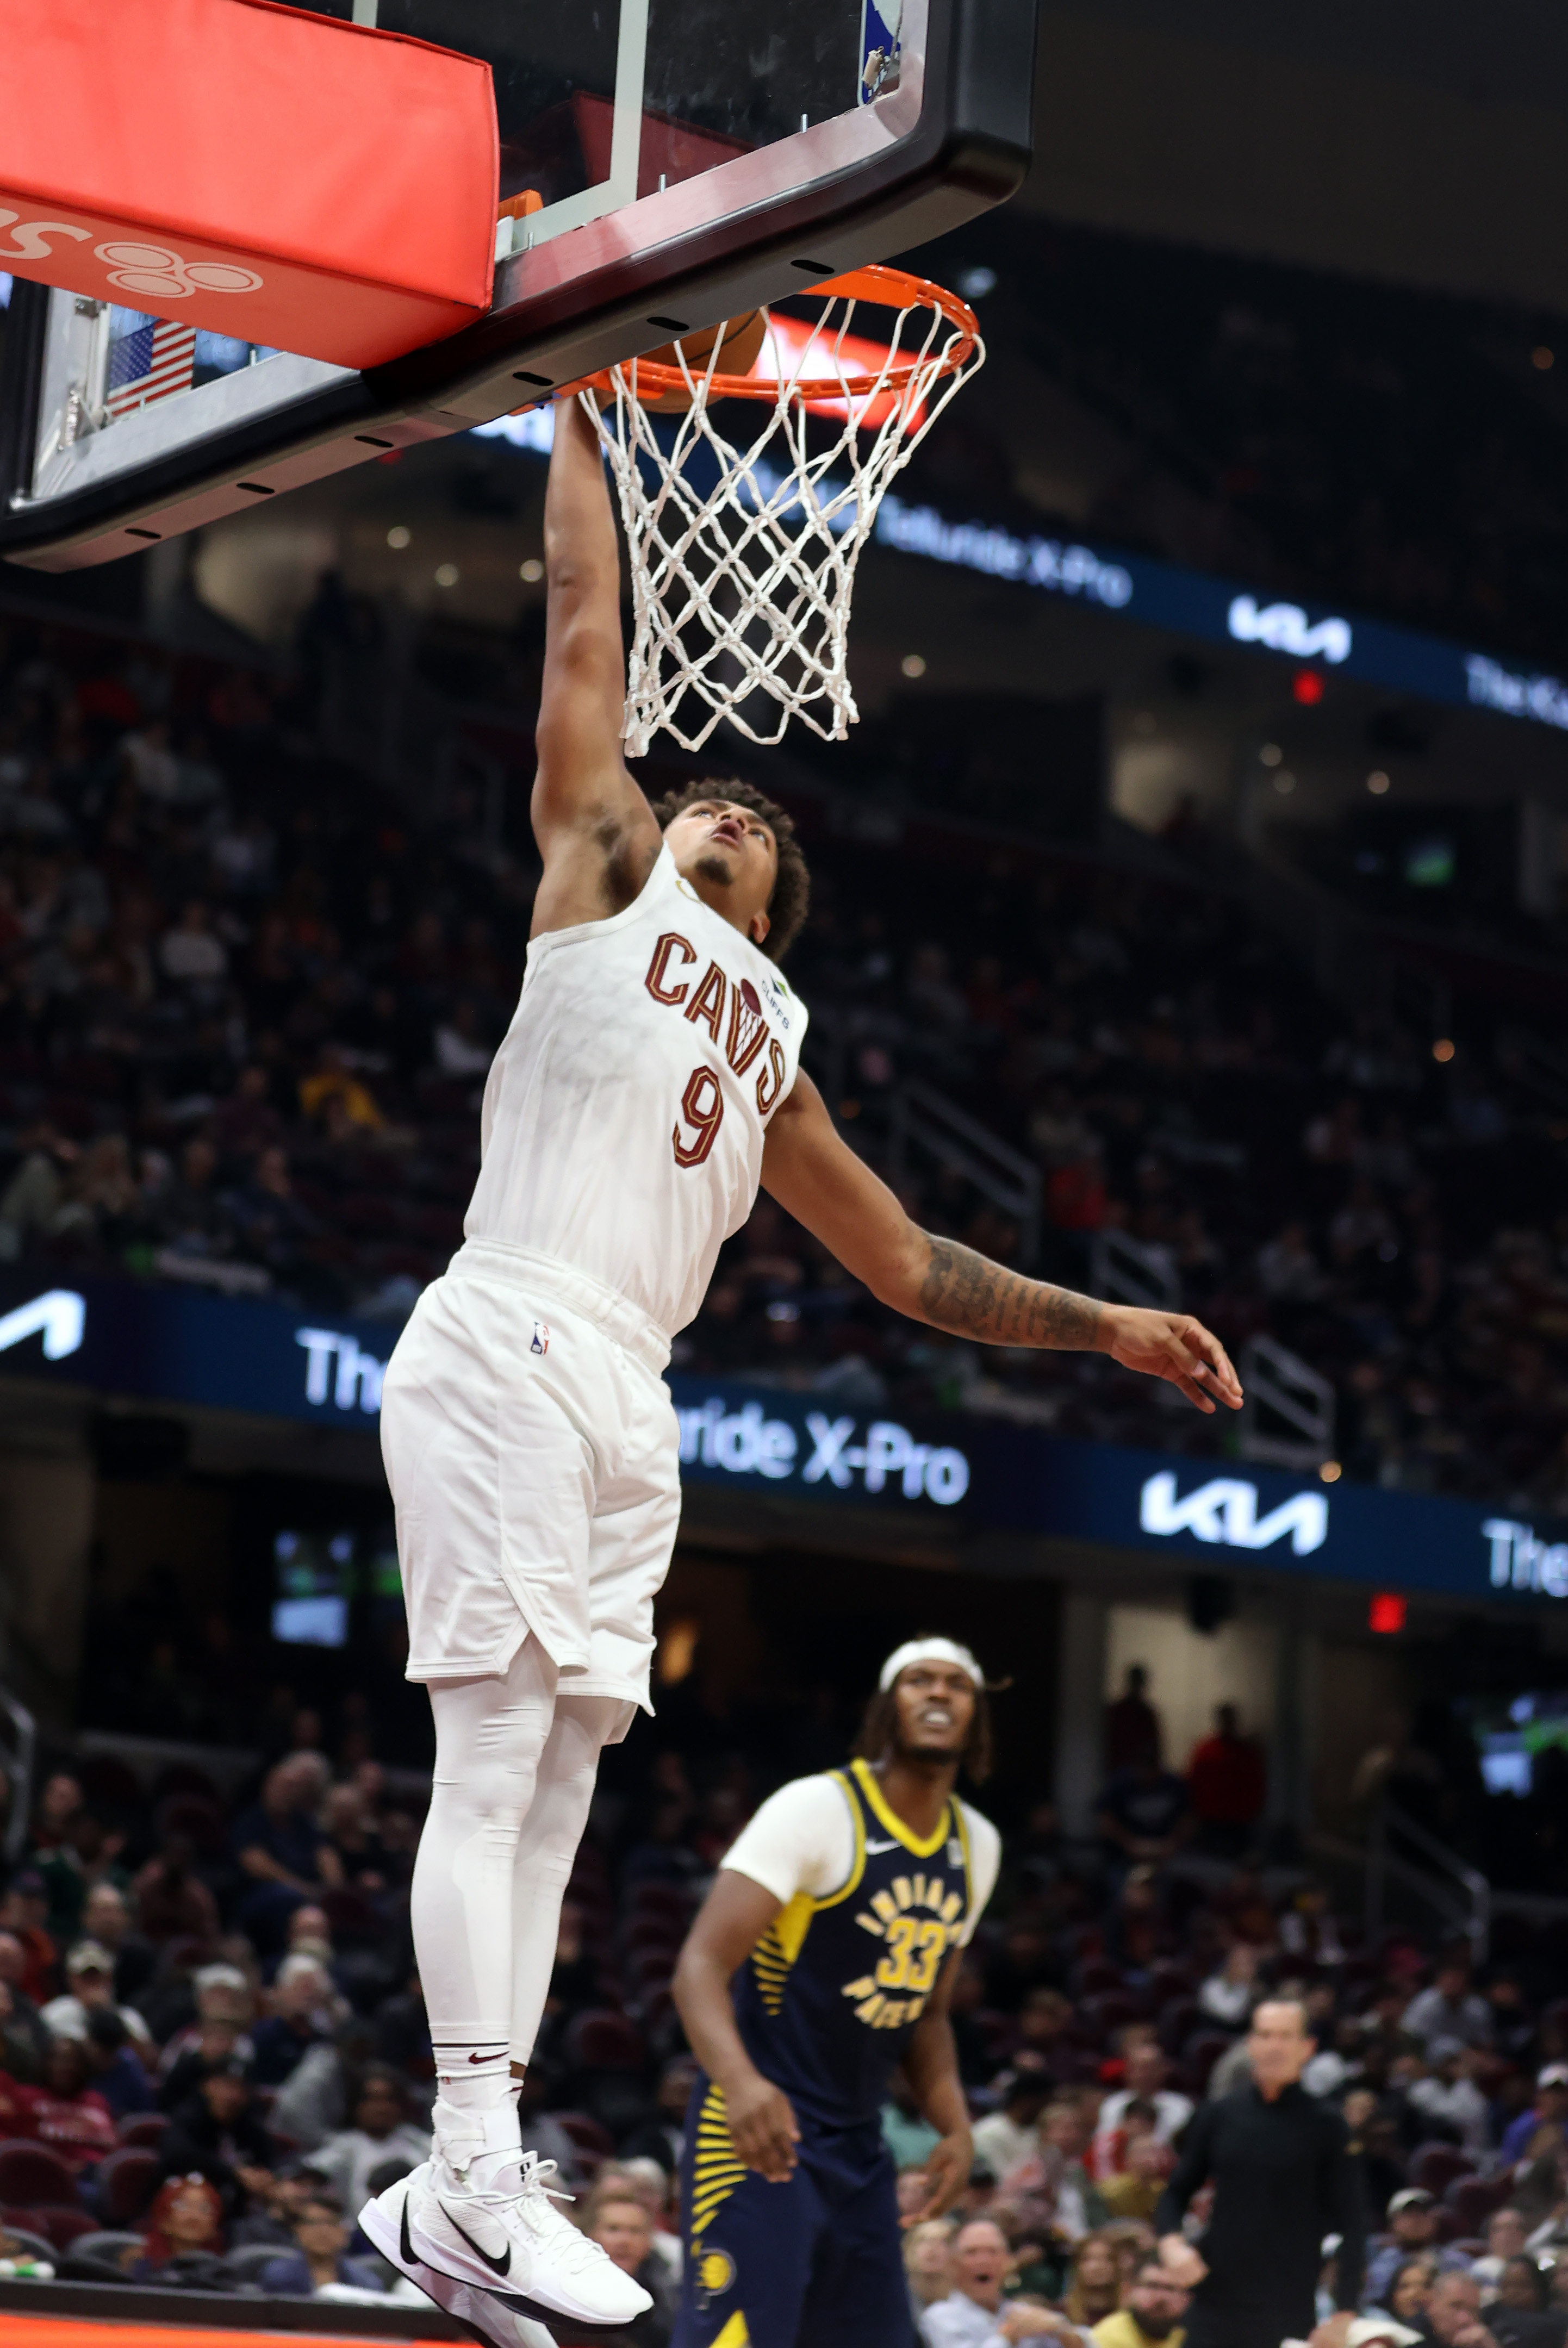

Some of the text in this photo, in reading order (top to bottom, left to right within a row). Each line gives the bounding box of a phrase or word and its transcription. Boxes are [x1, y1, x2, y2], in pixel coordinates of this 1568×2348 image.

[644, 932, 786, 1116] CAVS
[762, 979, 789, 1030] CLIFFS
[672, 1064, 724, 1169] 9
[801, 1412, 970, 1505] X-Pro
[875, 1915, 947, 1994] 33
